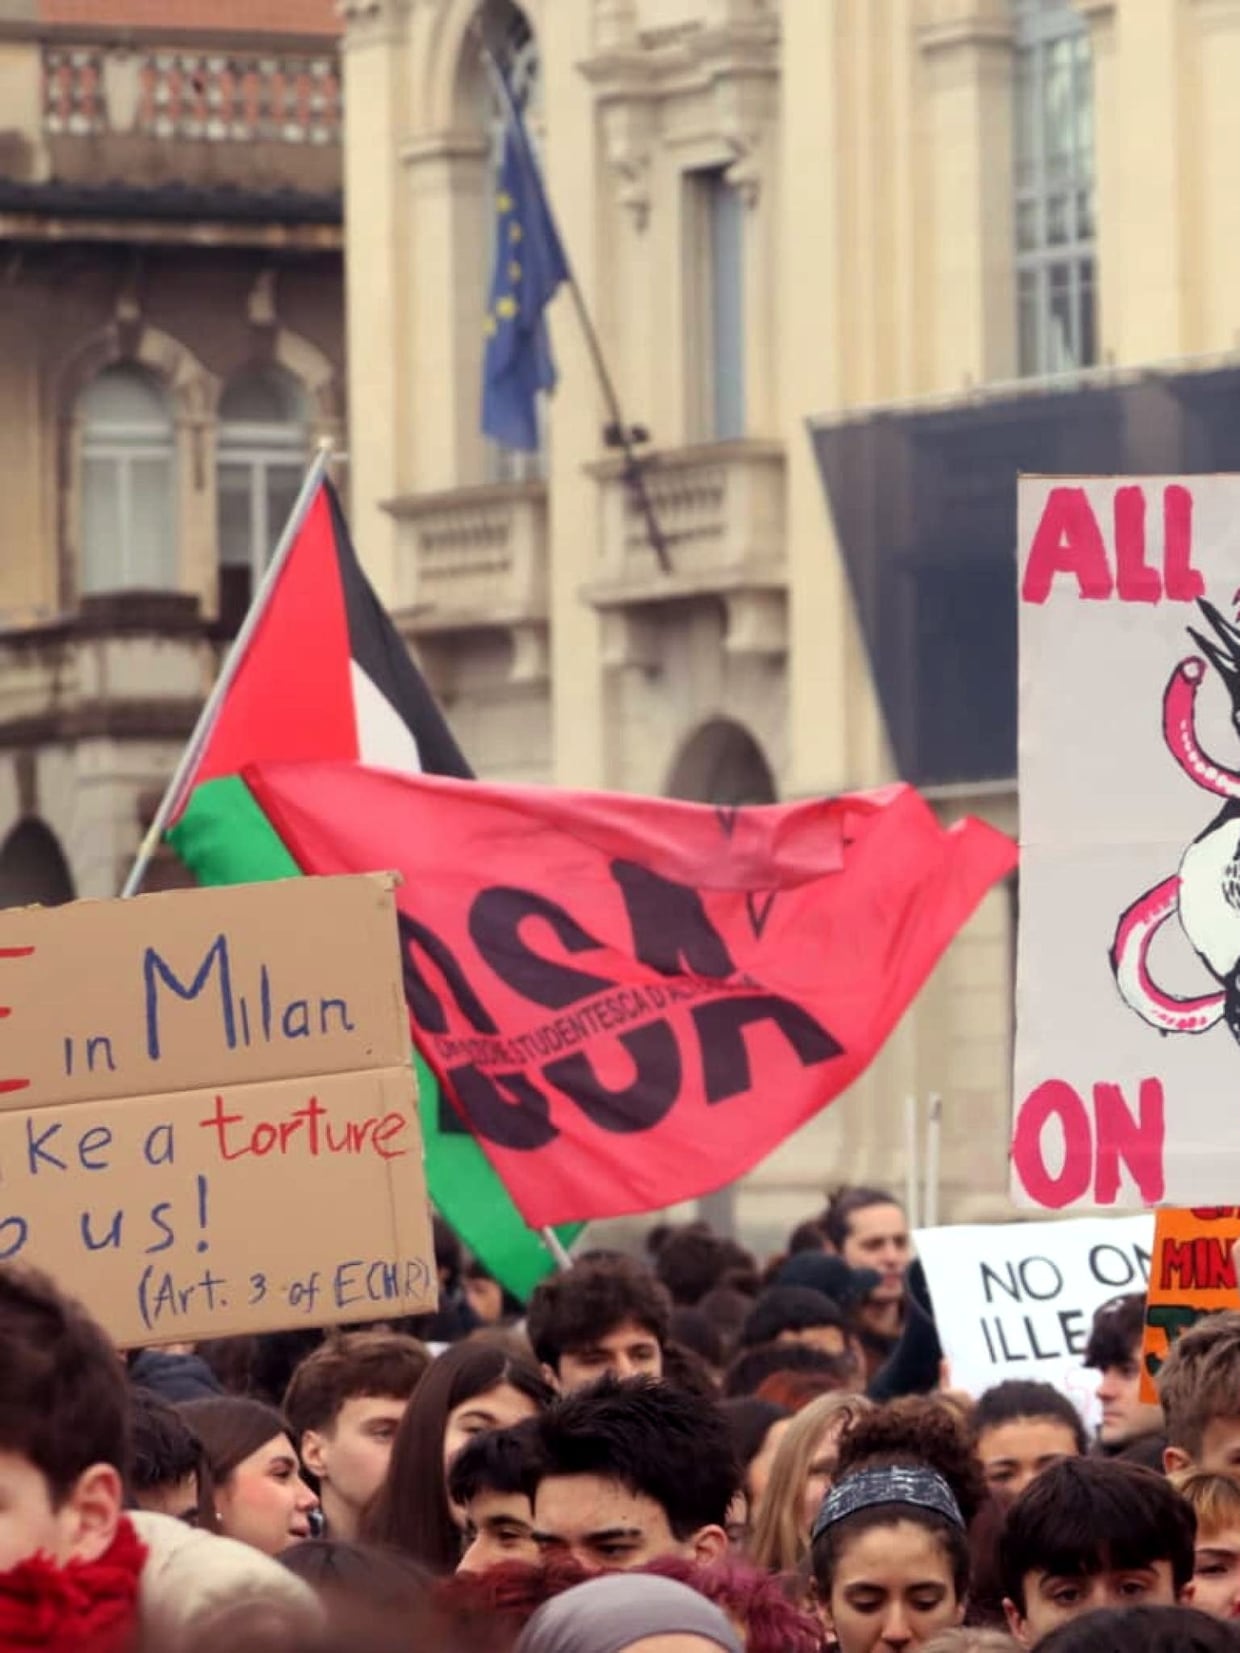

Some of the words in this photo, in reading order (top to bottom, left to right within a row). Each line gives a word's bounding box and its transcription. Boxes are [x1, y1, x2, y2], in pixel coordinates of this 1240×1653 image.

[1021, 484, 1205, 604] ALL
[64, 1036, 116, 1076] in
[27, 1117, 112, 1174] ke
[144, 1123, 174, 1164] a
[200, 1095, 406, 1161] torture
[1012, 1077, 1165, 1209] ON
[82, 1175, 208, 1254] us!
[138, 1264, 228, 1329] (Art.
[249, 1274, 267, 1299] 3
[980, 1255, 1063, 1303] NO
[1160, 1237, 1240, 1291] MIN
[980, 1309, 1087, 1363] ILLE
